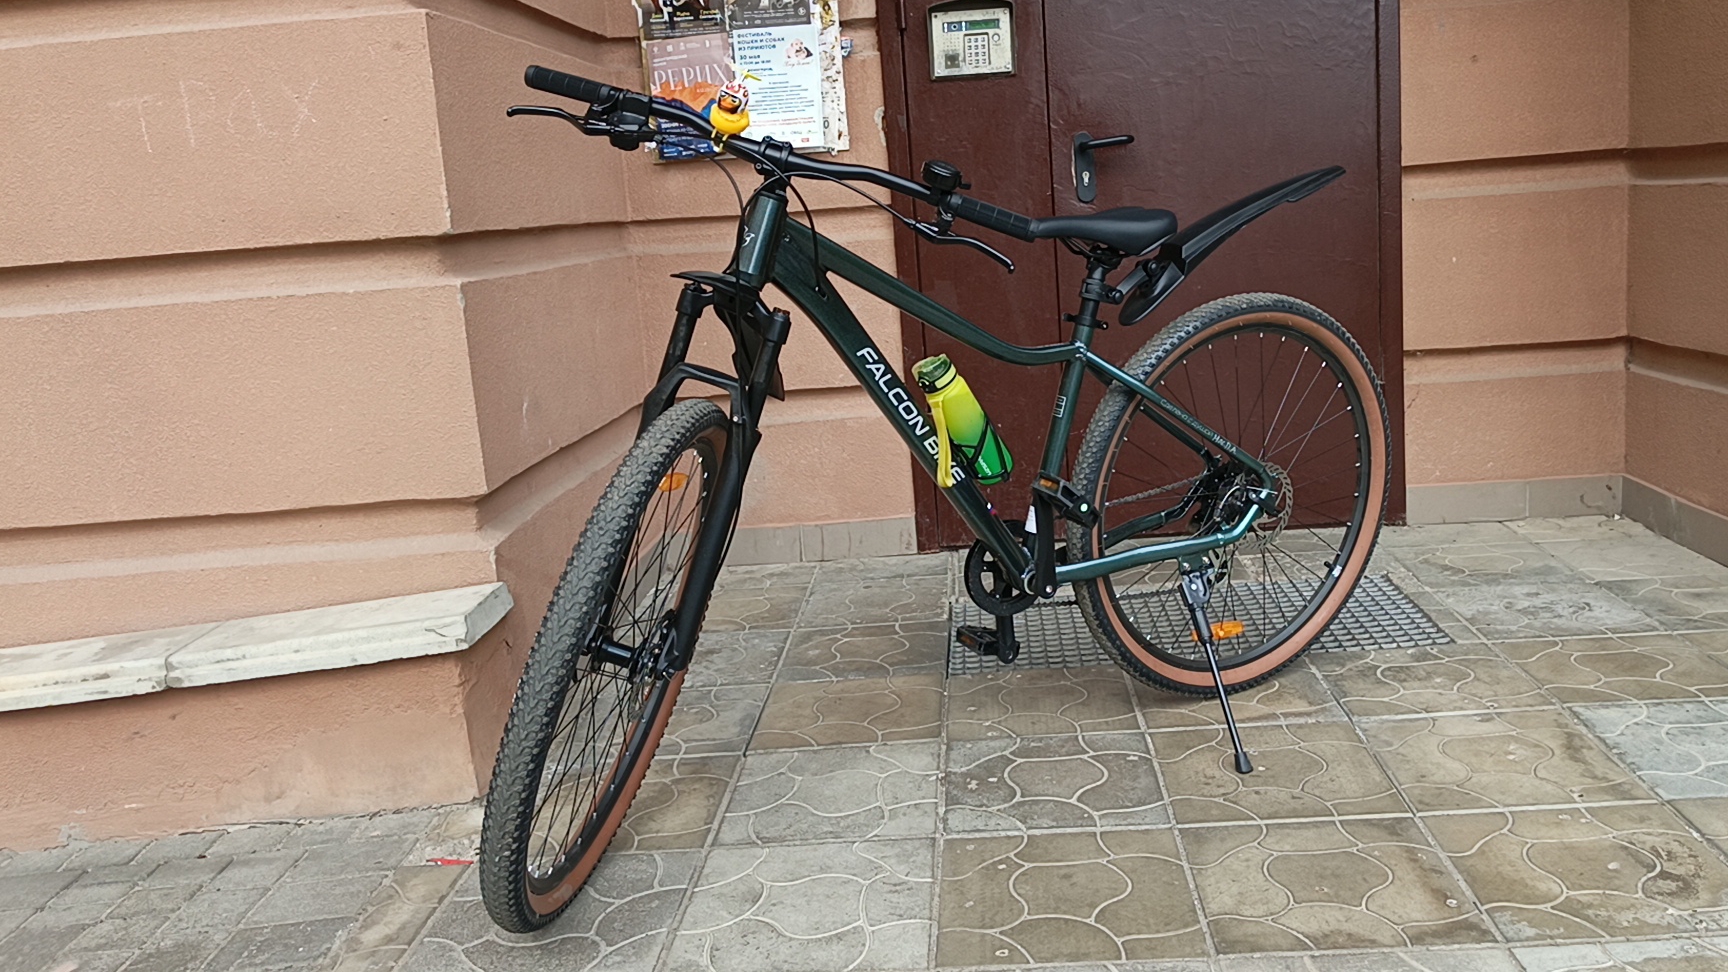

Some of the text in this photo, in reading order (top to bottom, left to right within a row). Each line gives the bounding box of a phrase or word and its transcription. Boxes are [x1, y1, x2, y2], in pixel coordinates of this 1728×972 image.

[654, 63, 730, 93] РЕРИХ
[856, 347, 965, 484] FALCON BE
